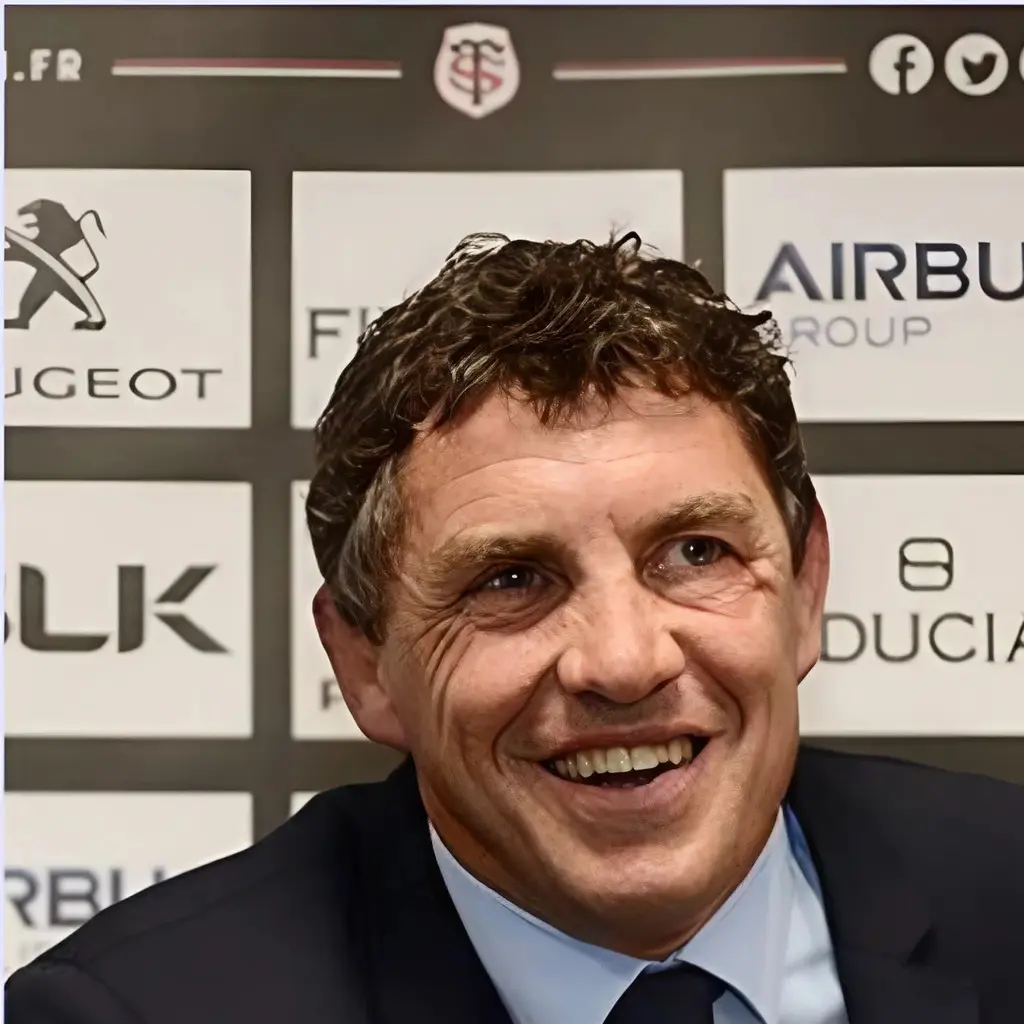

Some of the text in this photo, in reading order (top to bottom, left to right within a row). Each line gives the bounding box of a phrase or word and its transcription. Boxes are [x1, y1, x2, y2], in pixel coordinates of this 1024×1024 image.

[4, 48, 82, 82] .FR
[789, 316, 932, 348] ROUP
[4, 563, 232, 654] LK
